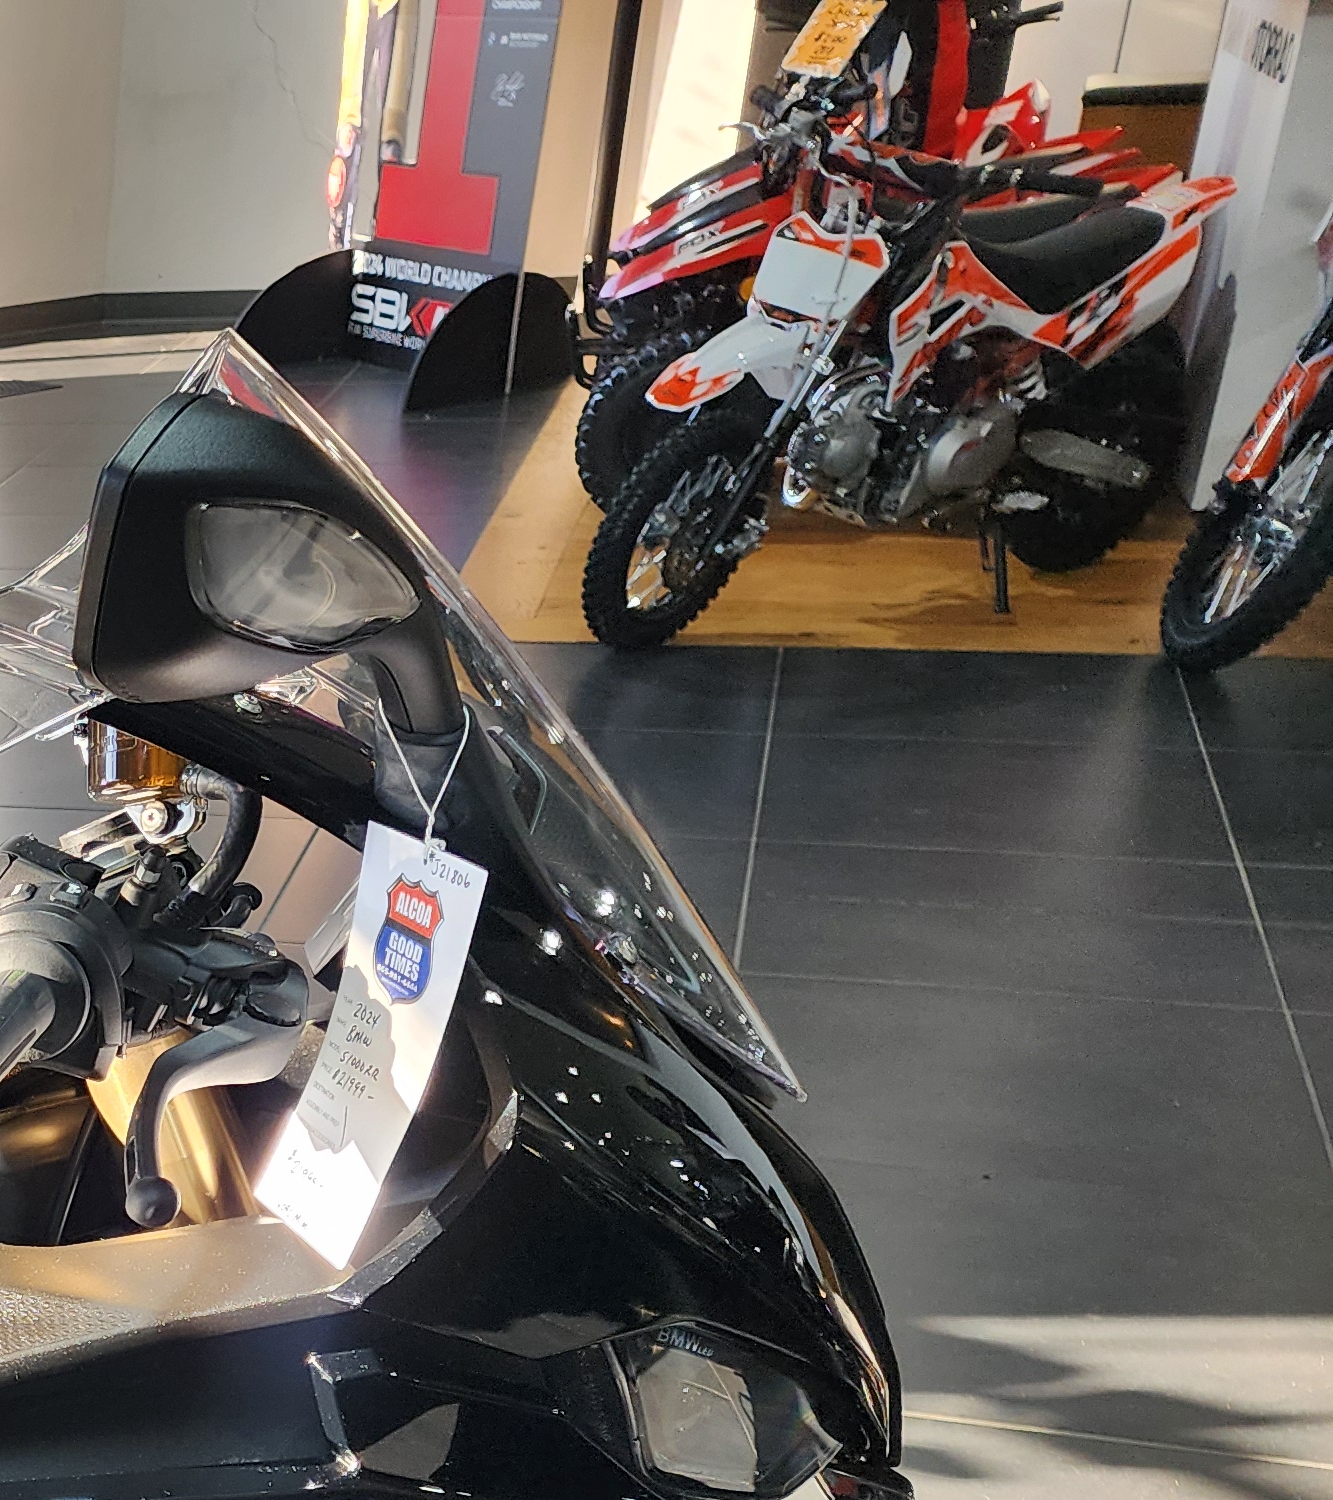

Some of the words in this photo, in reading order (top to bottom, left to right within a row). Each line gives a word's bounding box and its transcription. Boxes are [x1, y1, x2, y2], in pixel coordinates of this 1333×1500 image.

[394, 892, 433, 929] ALCOA
[388, 931, 424, 964] GOOD
[384, 947, 420, 982] TIMES
[353, 1002, 381, 1030] 2024
[345, 1024, 373, 1048] BMW
[658, 1326, 701, 1352] BMW
